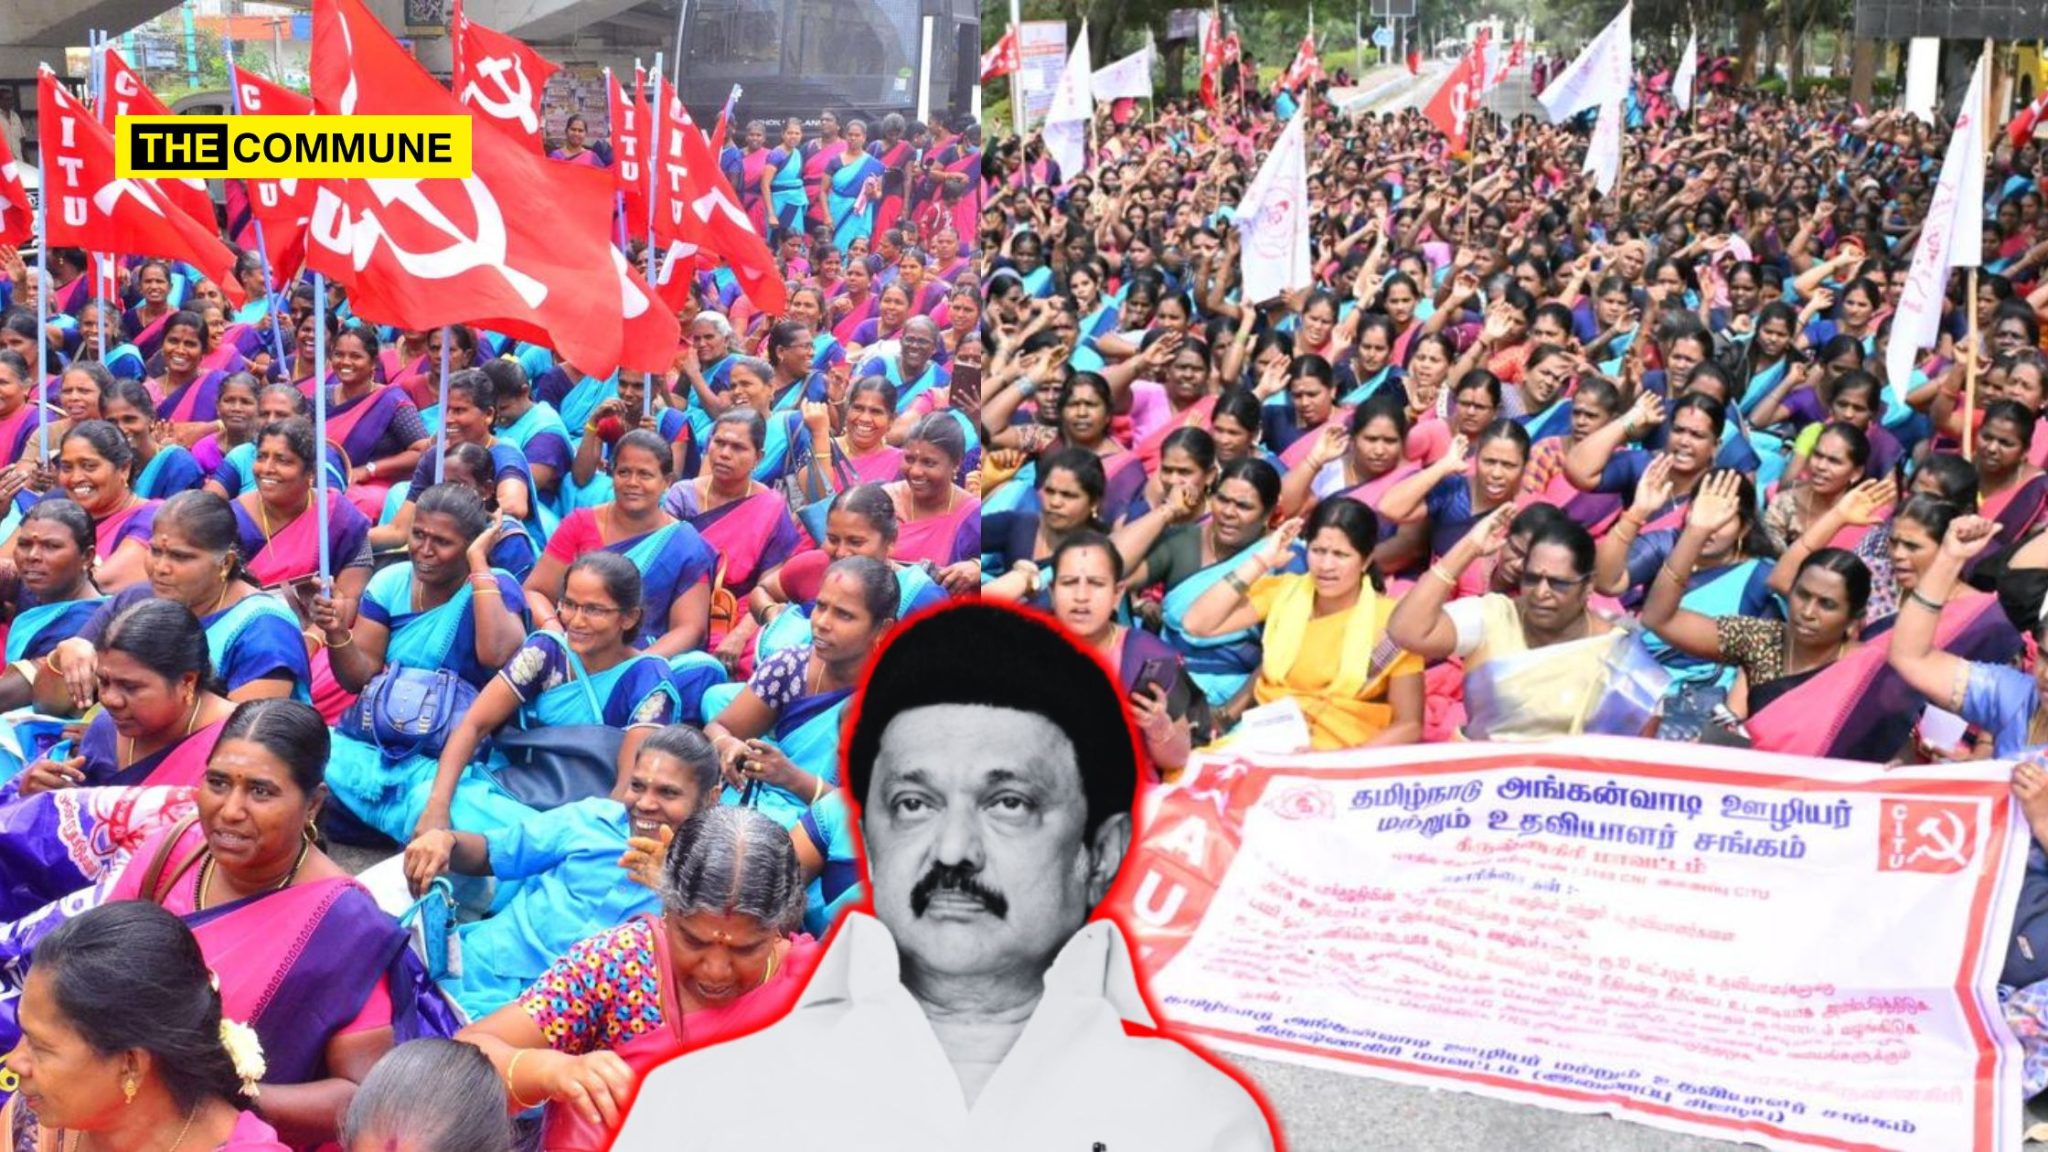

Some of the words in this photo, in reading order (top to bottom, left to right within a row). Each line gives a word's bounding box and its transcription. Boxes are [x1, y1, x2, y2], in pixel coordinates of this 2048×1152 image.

[1349, 779, 1484, 811] தமிழ்நாடு
[1496, 774, 1703, 820] அங்கன்வாடி
[1720, 793, 1853, 832] ஊழியர்
[1377, 807, 1471, 838] மற்றும்
[1487, 809, 1677, 850] உதவியாளர்
[1694, 830, 1806, 859] சங்கம்
[1889, 803, 1908, 868] CITU
[1593, 850, 1708, 874] மாவட்டம்
